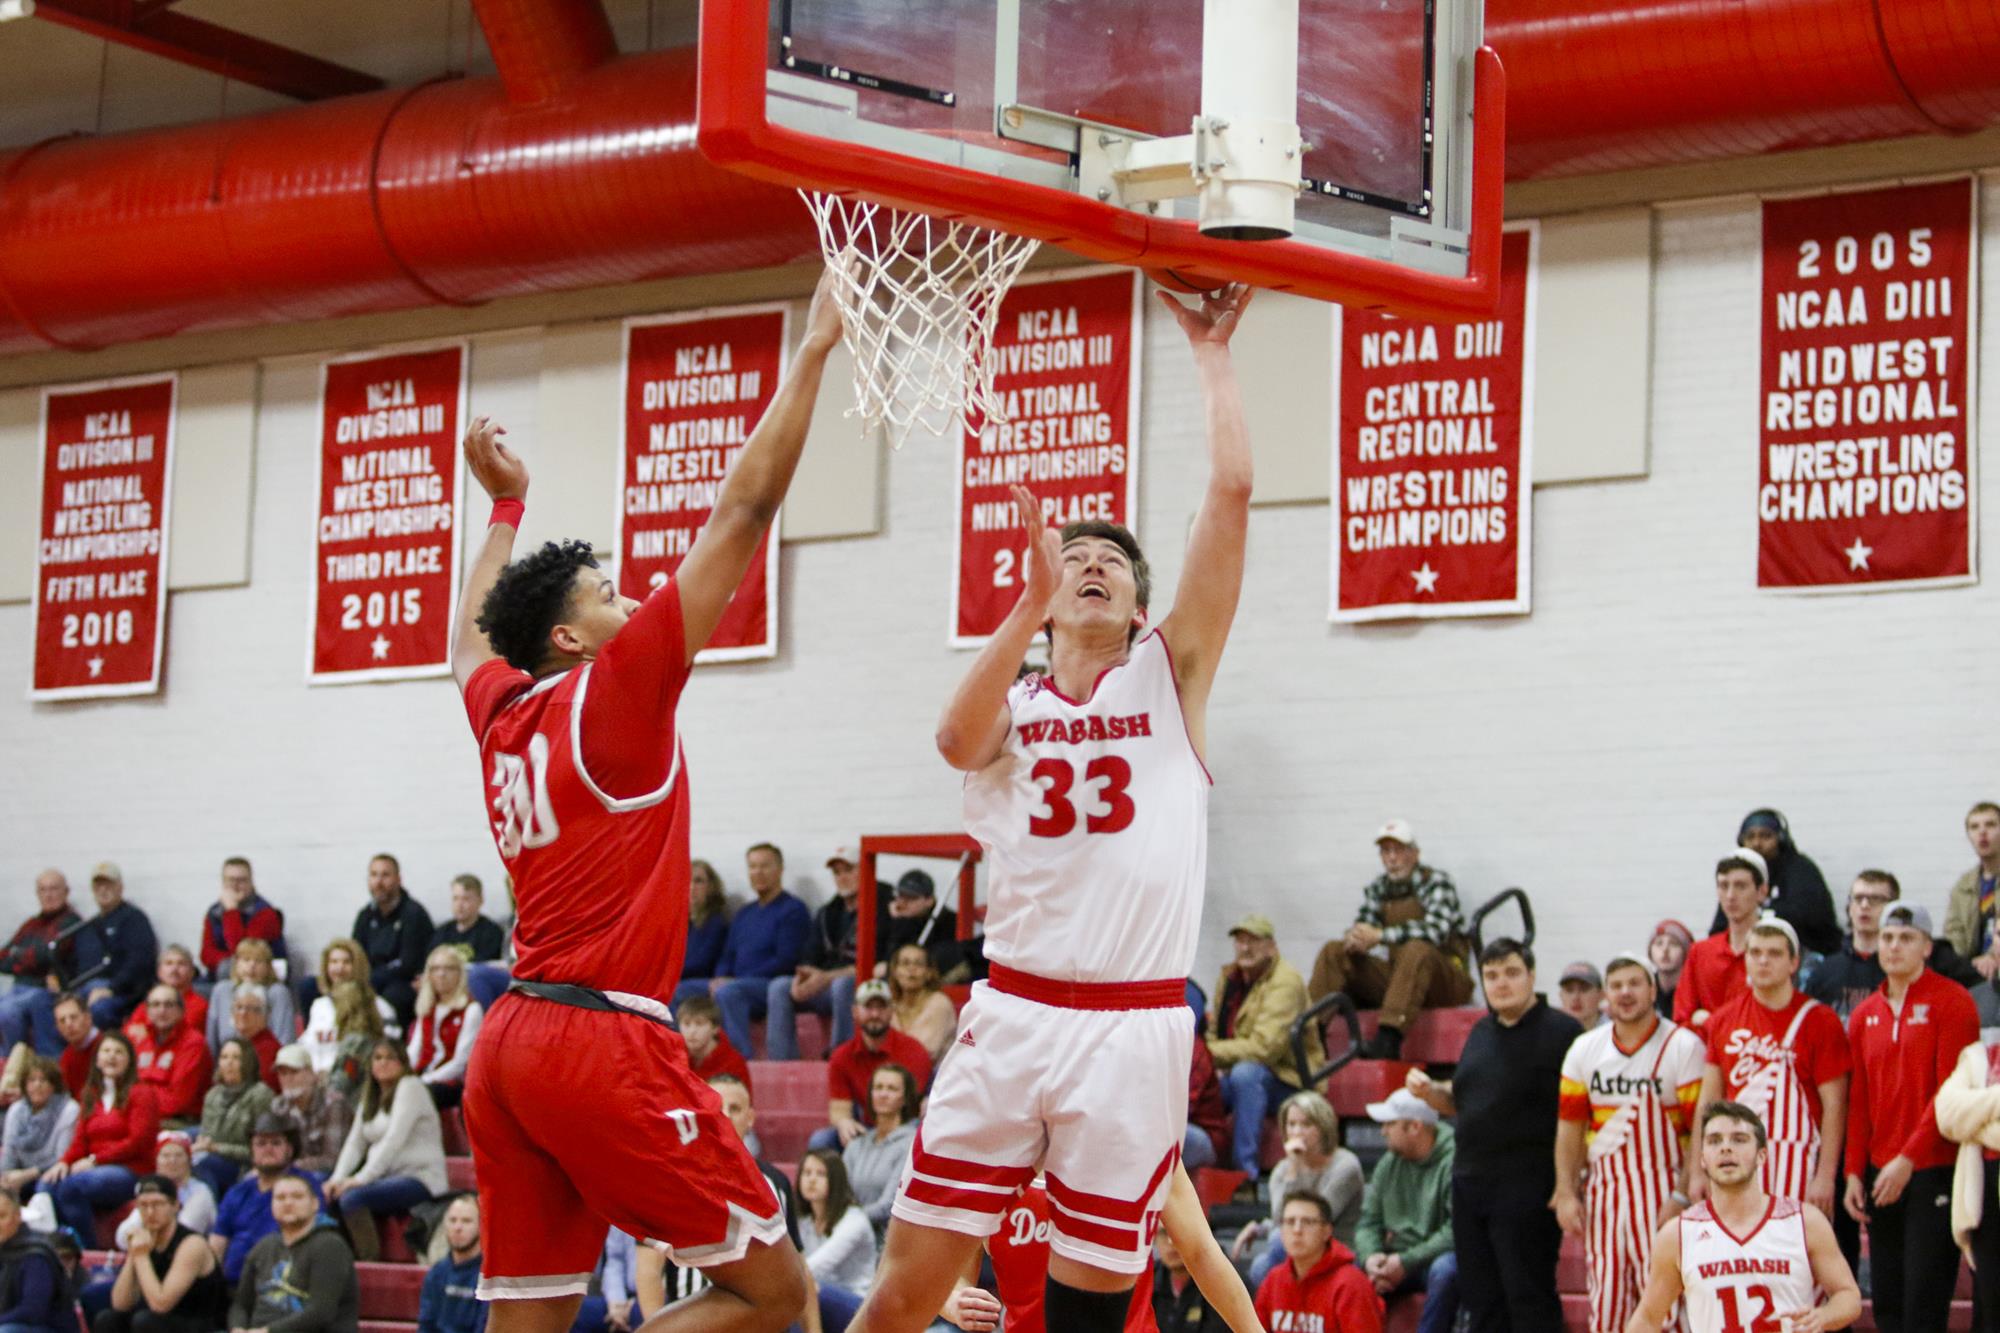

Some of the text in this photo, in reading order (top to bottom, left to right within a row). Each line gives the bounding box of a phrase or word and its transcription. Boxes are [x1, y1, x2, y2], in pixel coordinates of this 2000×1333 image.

[1797, 227, 1932, 279] 2005
[1018, 307, 1079, 341] NCAA
[1776, 276, 1952, 332] NCAA DIII
[675, 342, 732, 376] NCAA
[986, 334, 1112, 377] DIVISION III
[1361, 320, 1503, 369] NCAA DIII
[1778, 336, 1953, 390] MIDWEST
[366, 379, 415, 411] NCAA
[643, 370, 760, 411] DIVISION III
[1365, 377, 1495, 423] CENTRAL
[1766, 379, 1958, 431] REGIONAL
[84, 410, 130, 440] NCAA
[335, 404, 444, 445] DIVISION III
[649, 415, 747, 452] NATIONAL
[979, 413, 1112, 454] WRESTLING
[1358, 416, 1498, 463] REGIONAL
[57, 437, 134, 471] DIVISION
[342, 446, 434, 483] NATIONAL
[636, 446, 743, 483] WRESTLI
[965, 444, 1125, 488] CHAMPIONSHIPS
[1768, 431, 1955, 482] WRESTLING
[63, 475, 144, 507] NATIONAL
[333, 475, 442, 512] WRESTLING
[626, 480, 723, 516] CHAMPION
[1347, 465, 1508, 513] WRESTLING
[1760, 469, 1966, 522] CHAMPIONS
[53, 501, 152, 536] WRESTLING
[320, 502, 452, 544] CHAMPIONSHIPS
[972, 491, 1115, 532] NINT PLACE
[1347, 506, 1508, 552] CHAMPIONS
[41, 529, 160, 565] CHAMPIONSHIPS
[632, 527, 690, 559] NINTH
[326, 546, 442, 583] THIRD PLACE
[47, 569, 148, 603] FIFTH PLACE
[62, 609, 133, 648] 2018
[341, 588, 421, 630] 2015
[1016, 712, 1152, 747] WABASH
[1029, 755, 1136, 838] 33
[1698, 1258, 1791, 1280] WABASH
[1716, 1284, 1782, 1333] 12
